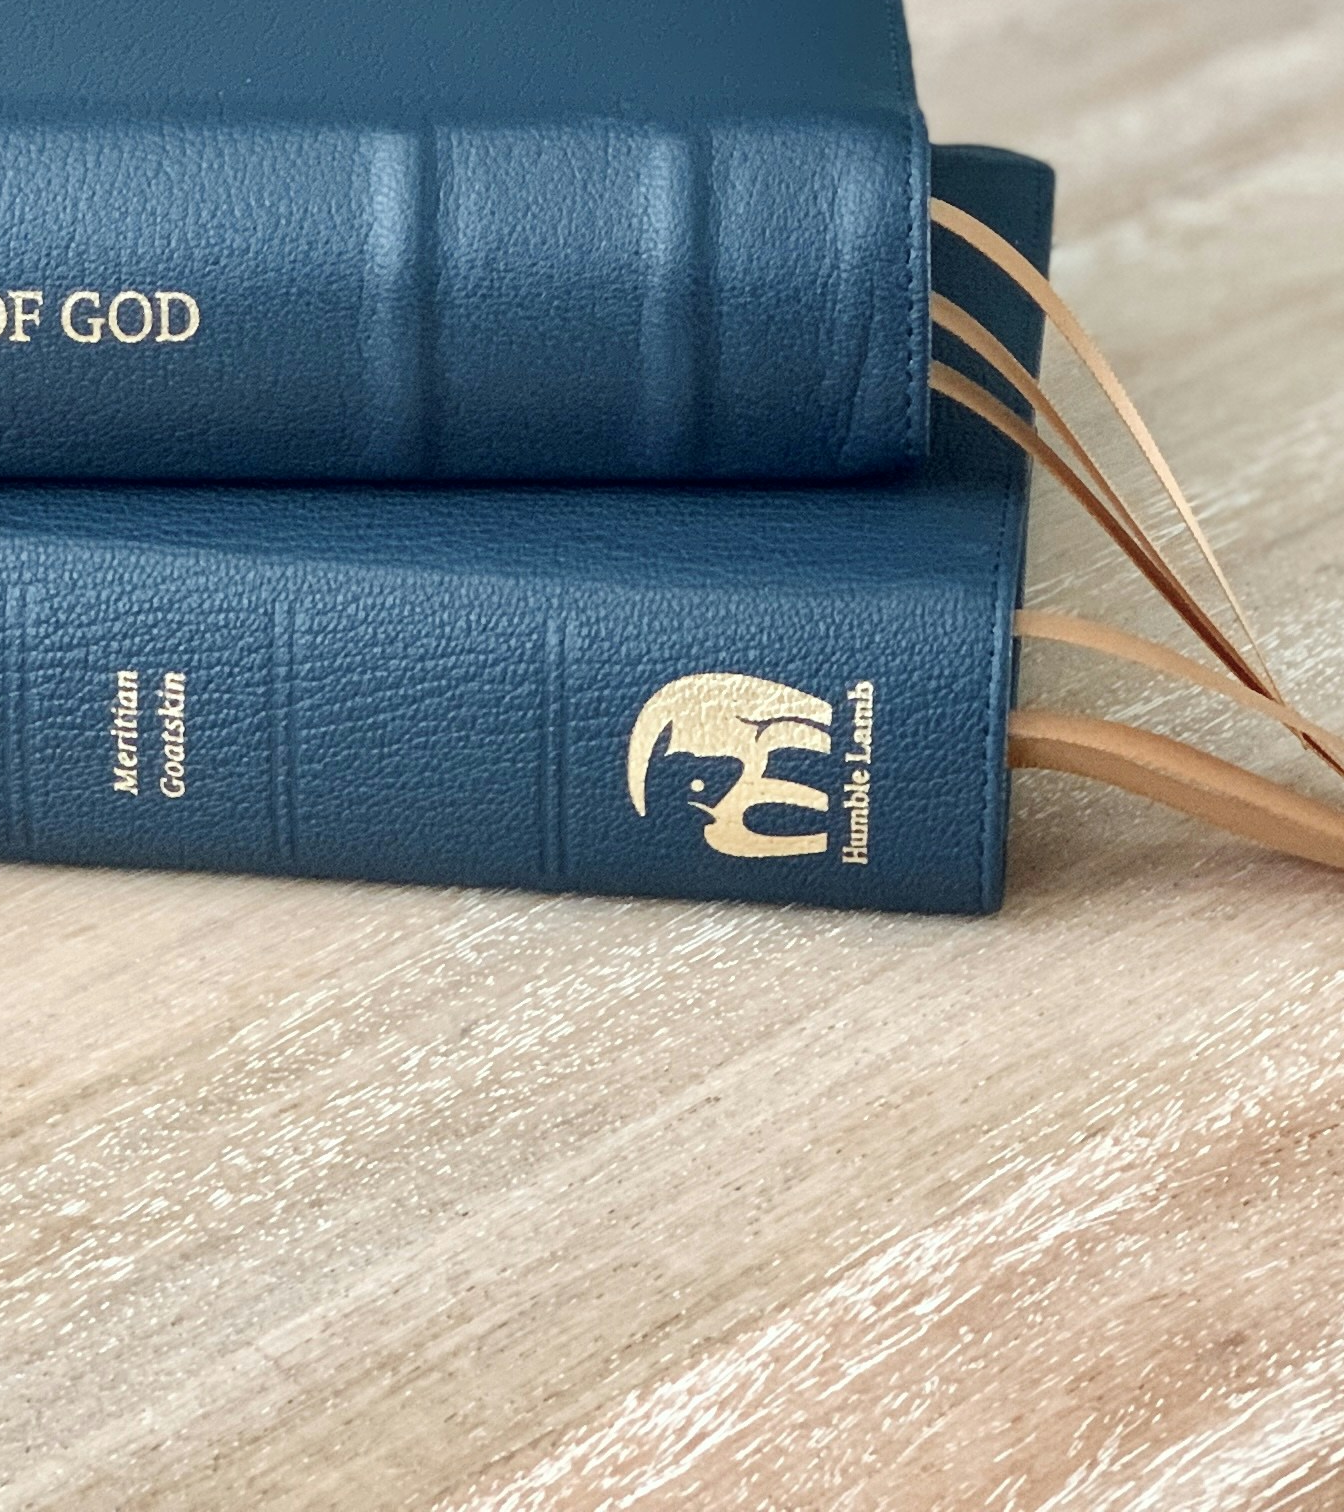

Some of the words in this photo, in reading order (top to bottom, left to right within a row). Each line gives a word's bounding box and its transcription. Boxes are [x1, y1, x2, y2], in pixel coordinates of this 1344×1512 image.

[60, 290, 202, 345] GOD
[110, 669, 140, 797] Meritian
[157, 671, 188, 799] Goatskin
[844, 681, 875, 764] Lamb
[842, 769, 871, 865] Humble
